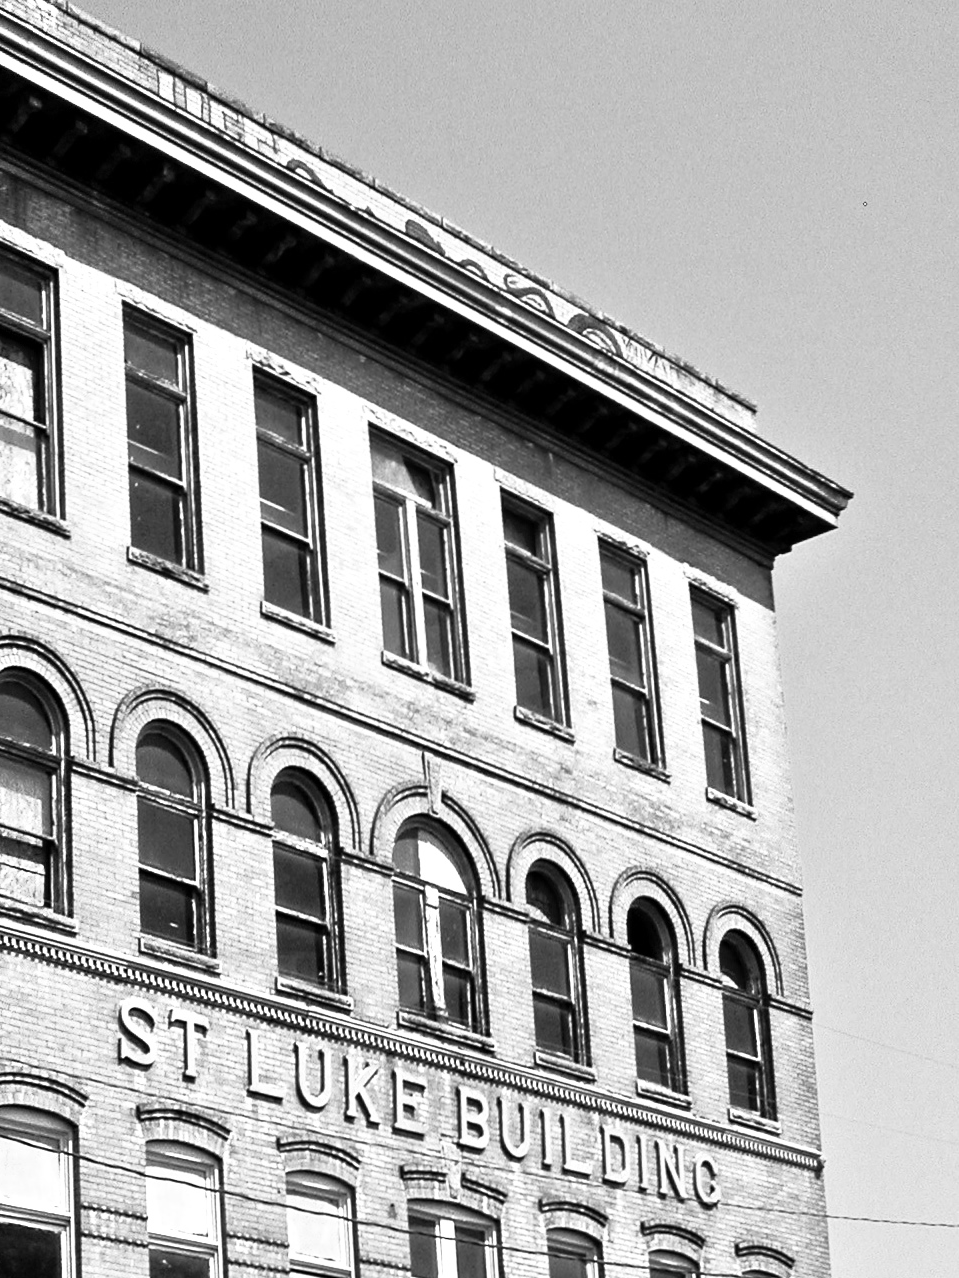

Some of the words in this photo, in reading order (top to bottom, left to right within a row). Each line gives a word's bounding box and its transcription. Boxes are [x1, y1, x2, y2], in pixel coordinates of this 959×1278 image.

[117, 997, 210, 1084] ST
[245, 1029, 428, 1141] LUKE
[455, 1086, 722, 1210] BUILDING
